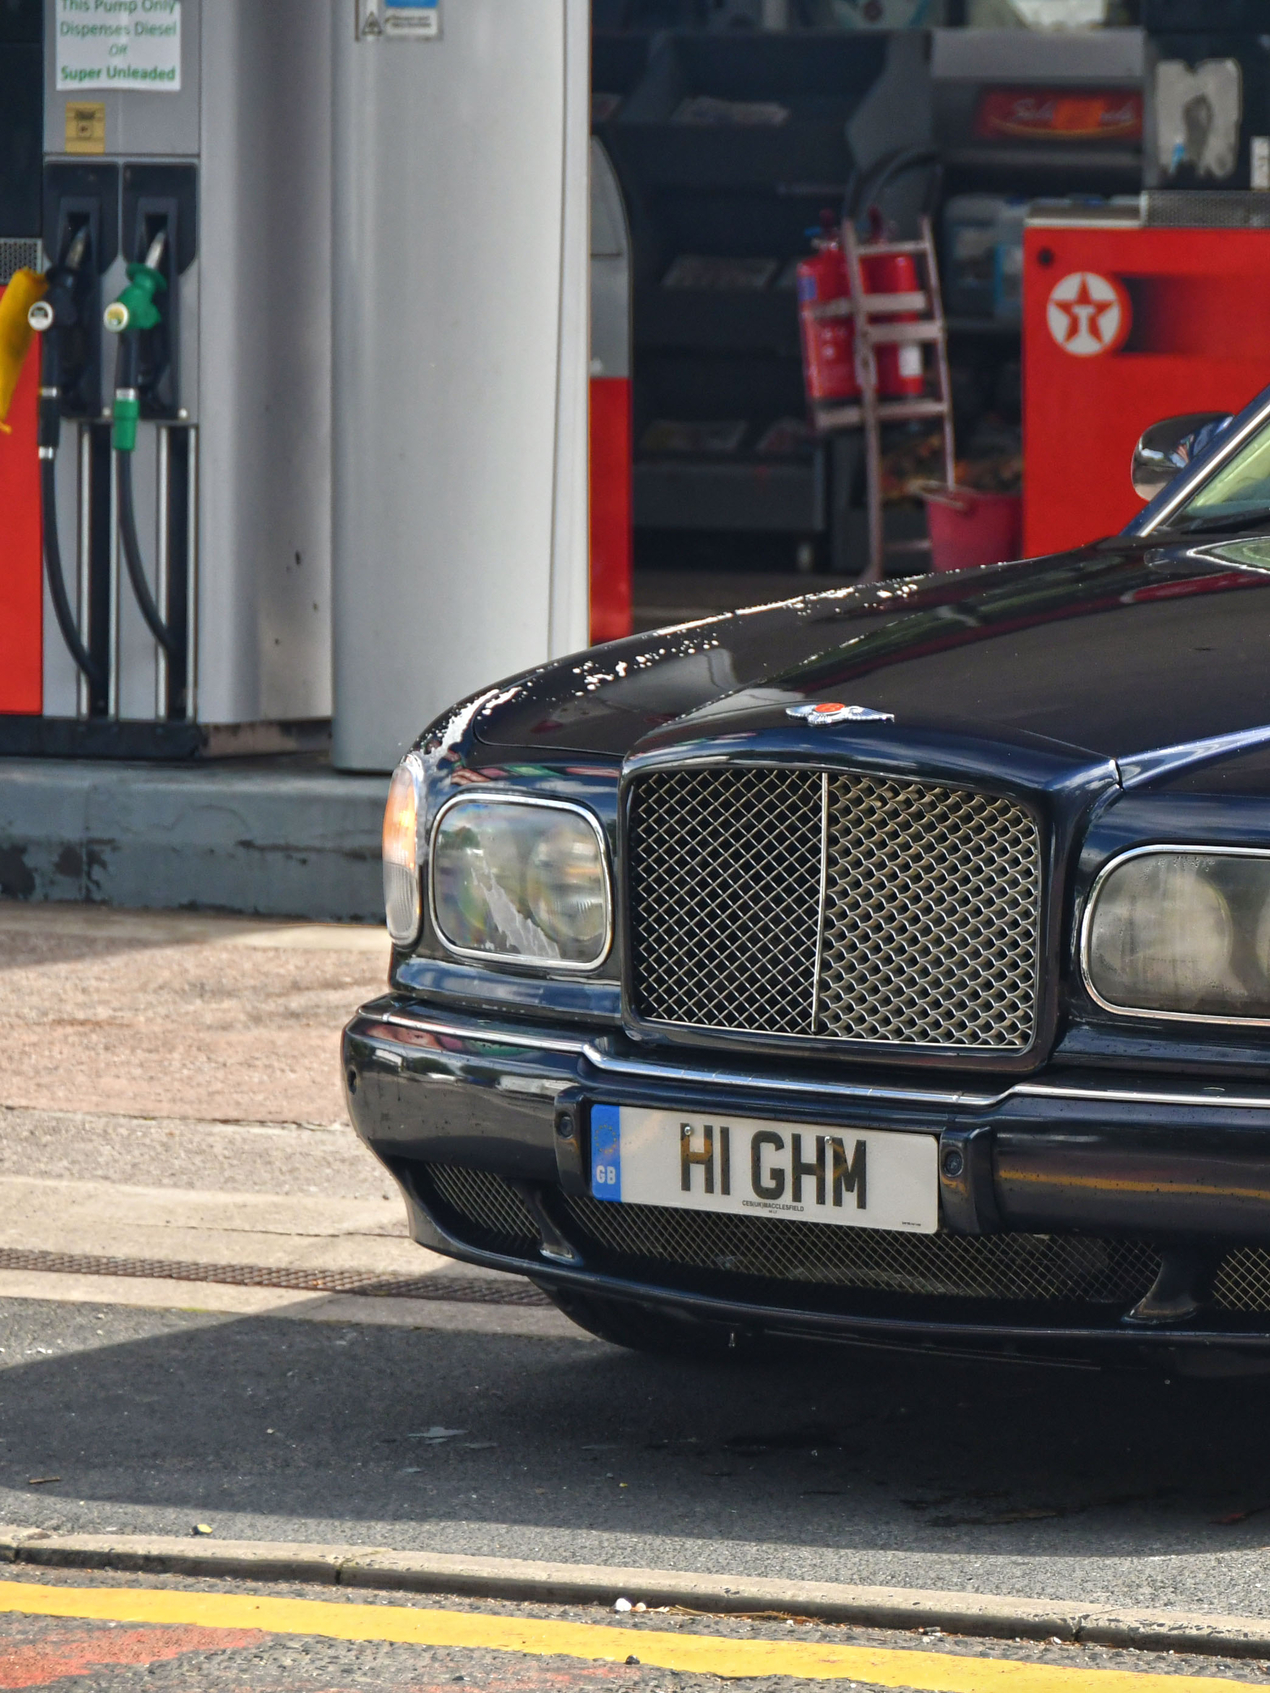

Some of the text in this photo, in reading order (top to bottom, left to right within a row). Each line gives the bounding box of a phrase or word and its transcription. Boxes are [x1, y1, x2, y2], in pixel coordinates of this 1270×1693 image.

[62, 0, 176, 14] This Pump Only
[60, 21, 177, 39] Dispenses Diesel
[61, 65, 176, 82] Super Unleaded
[595, 1165, 616, 1185] GB
[750, 1130, 867, 1210] GHM
